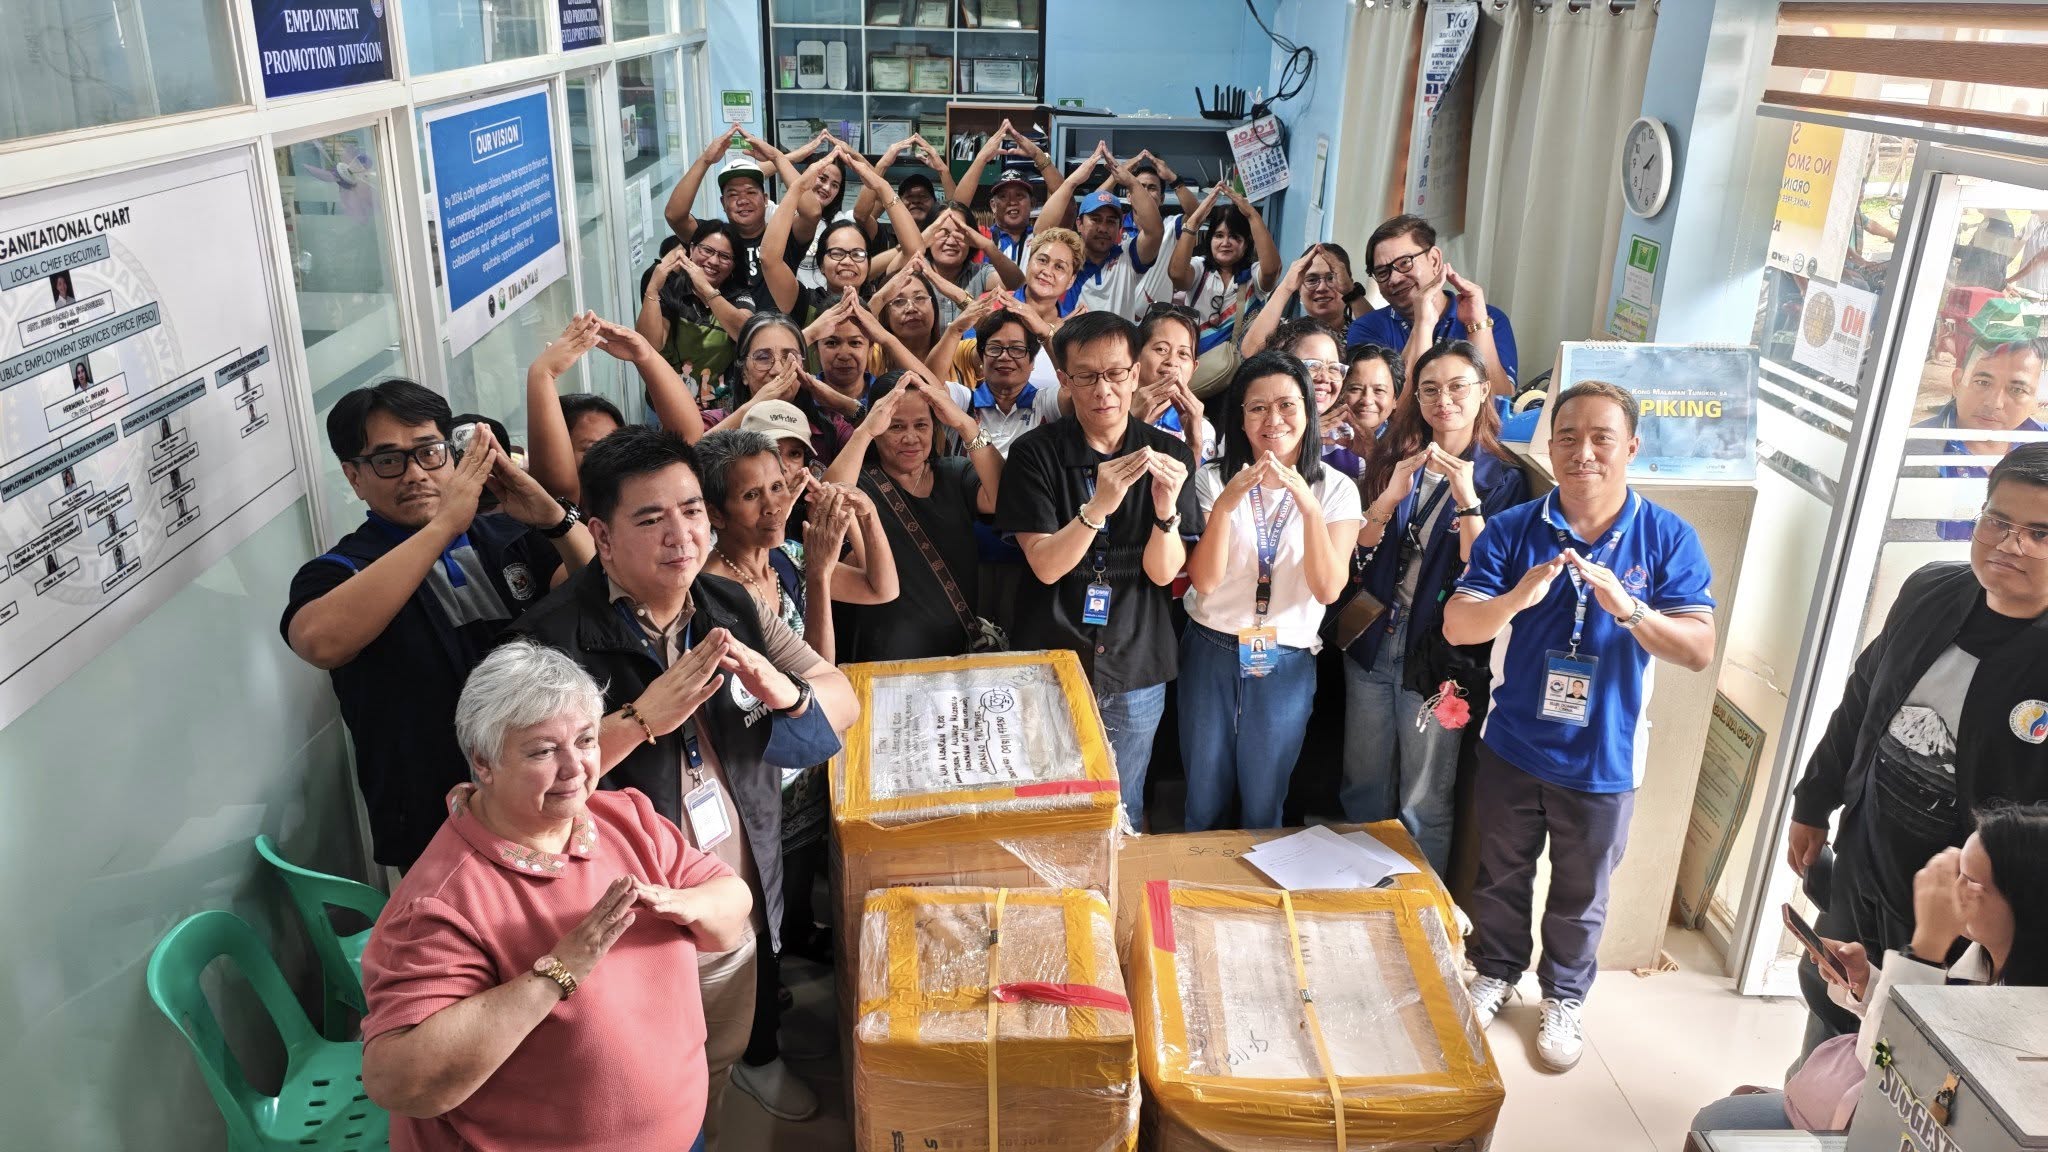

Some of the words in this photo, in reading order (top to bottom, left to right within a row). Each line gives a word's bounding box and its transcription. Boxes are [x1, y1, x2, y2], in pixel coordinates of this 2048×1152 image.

[284, 8, 359, 33] EMPLOYMENT
[563, 10, 573, 24] AND
[573, 8, 597, 22] PRODUCTION
[263, 46, 336, 75] PROMOTION
[338, 42, 382, 66] DIVISION
[476, 132, 492, 155] OUR
[491, 124, 518, 149] VISION
[1641, 132, 1647, 143] 11
[1649, 128, 1655, 140] 12
[1635, 143, 1641, 154] 10
[1632, 158, 1637, 169] 9
[467, 185, 475, 201] city
[475, 180, 488, 195] where
[487, 174, 501, 190] citizens
[501, 170, 511, 184] have
[517, 164, 528, 178] space
[1633, 176, 1638, 188] 8
[455, 204, 480, 227] meaningful
[480, 200, 488, 212] and
[511, 184, 522, 200] taking
[522, 176, 541, 194] advantage
[1645, 196, 1649, 206] 6
[0, 217, 93, 260] GANIZATIONAL
[93, 206, 131, 232] CHART
[449, 228, 475, 249] abundance
[475, 223, 483, 235] and
[483, 214, 503, 233] protection
[451, 245, 480, 269] collaborative
[480, 240, 489, 253] and
[511, 217, 532, 238] government
[532, 212, 540, 223] that
[11, 265, 39, 283] LOCAL
[40, 255, 63, 274] CHIEF
[64, 244, 102, 266] EXECUTIVE
[482, 254, 500, 274] equitable
[500, 241, 524, 262] opportunities
[67, 316, 80, 328] Mayor
[24, 341, 77, 372] EMPLOYMENT
[78, 327, 111, 350] SERVICES
[111, 316, 136, 337] OFFICE
[135, 308, 158, 330] (PESO)
[1640, 399, 1722, 418] PIKING
[2, 471, 36, 496] EMPLOYMENT
[35, 459, 64, 479] PROMOTION
[96, 429, 116, 443] DIVISION
[1270, 529, 1280, 547] CITY
[1275, 518, 1283, 528] OF
[744, 703, 773, 729] DMW
[936, 715, 946, 728] RIOS
